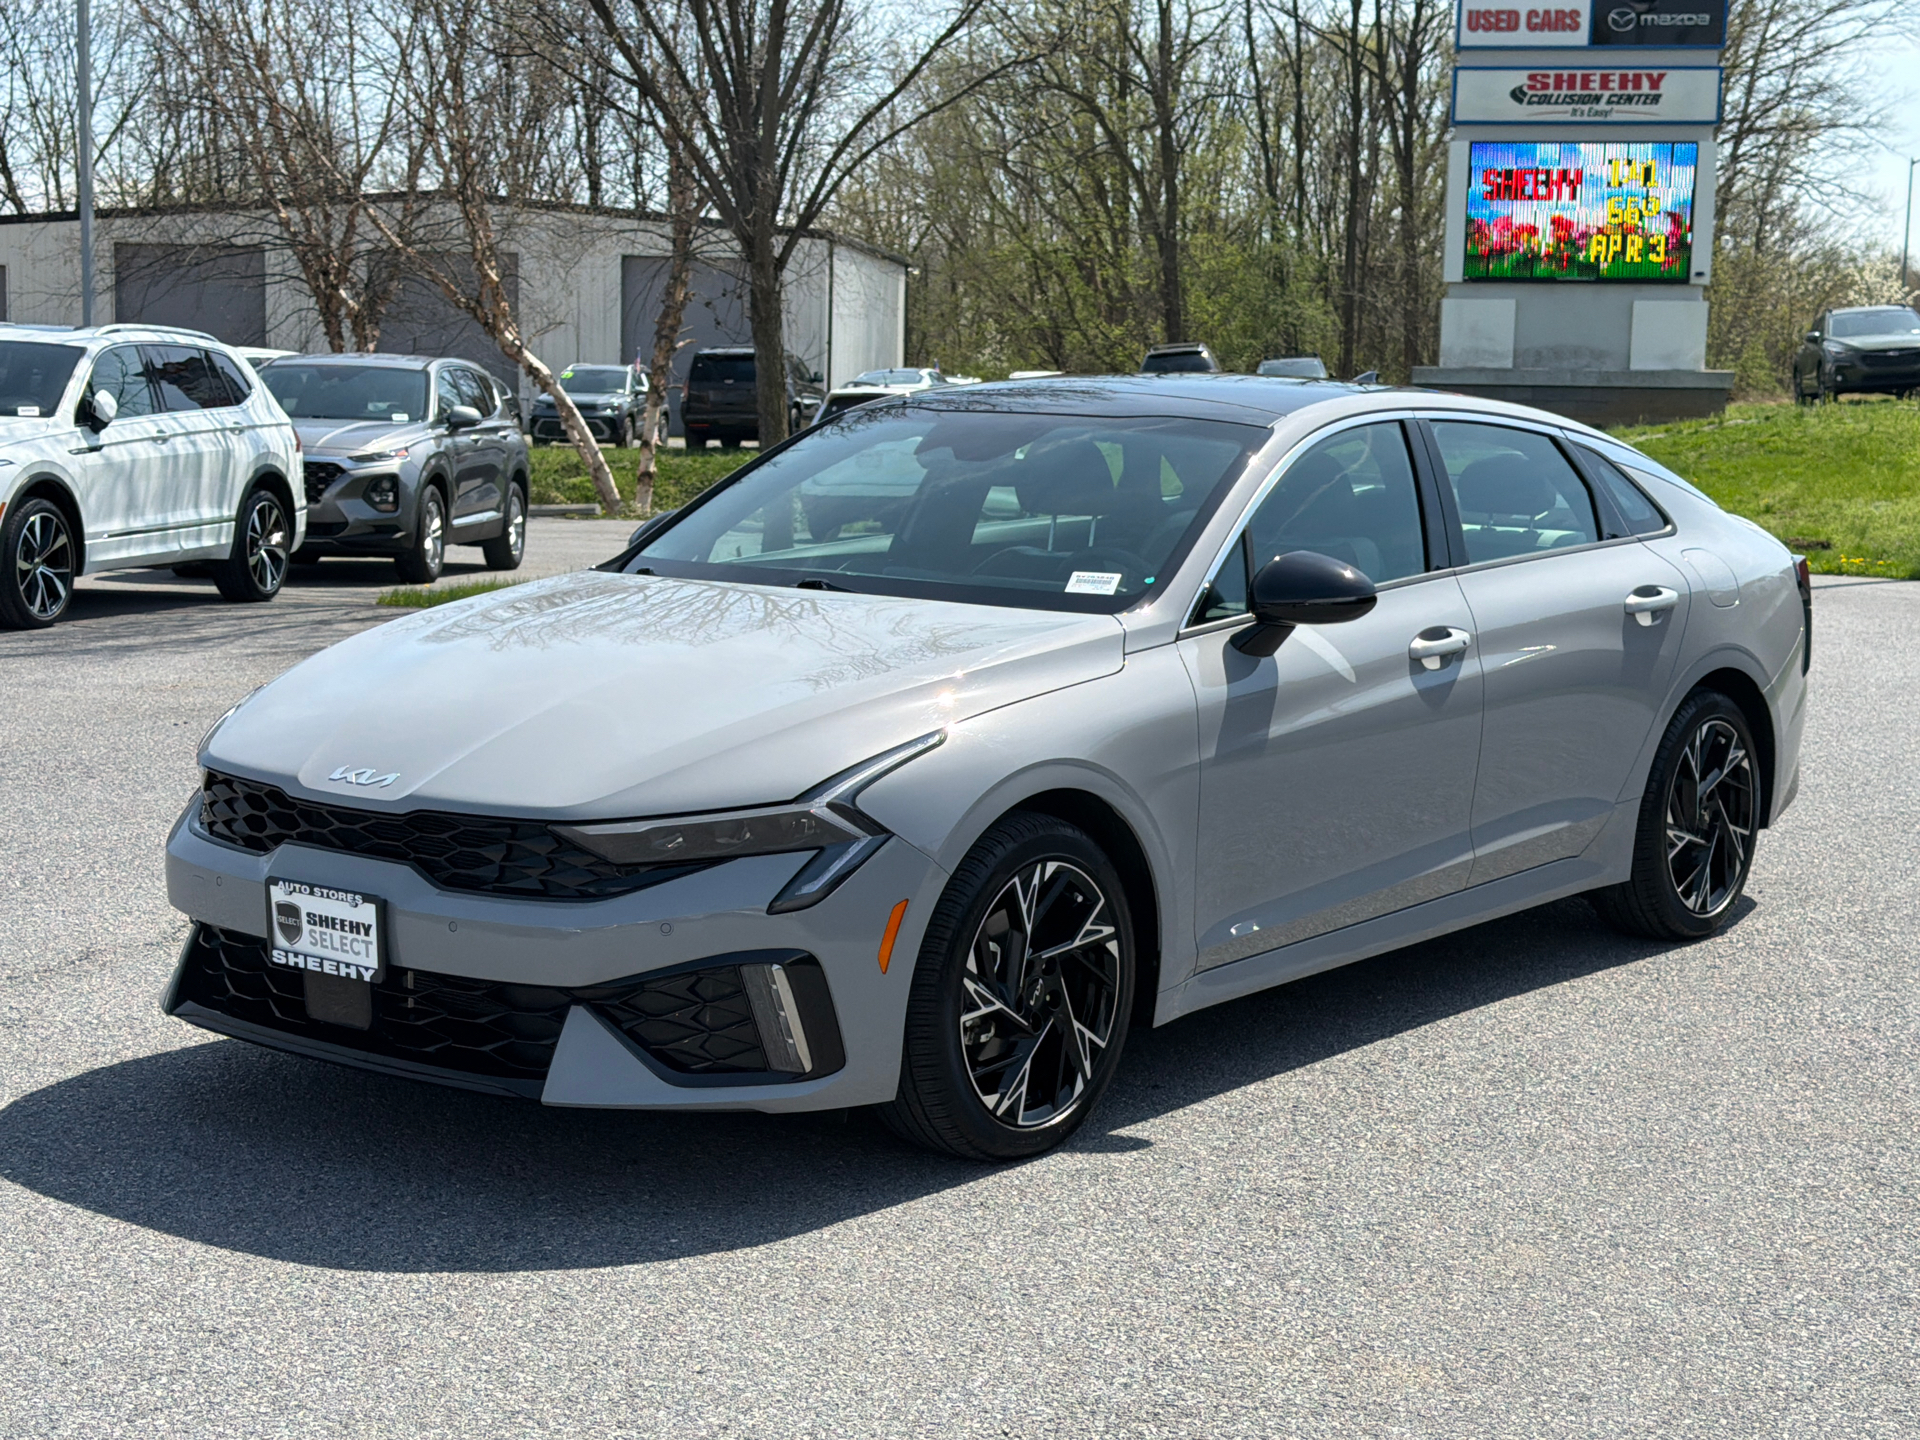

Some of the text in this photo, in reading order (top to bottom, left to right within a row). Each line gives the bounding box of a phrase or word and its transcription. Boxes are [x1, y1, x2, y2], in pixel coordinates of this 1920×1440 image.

[1467, 9, 1581, 33] USED CARS
[1640, 13, 1710, 26] mazda
[1527, 72, 1667, 91] SHEEHY
[1526, 93, 1662, 106] COLLISION CENTER
[1570, 107, 1614, 118] It's Easy!
[278, 881, 364, 905] AUTO STORES
[277, 915, 300, 927] SELECT
[306, 911, 373, 938] SHEEHY
[308, 929, 374, 959] SELECT
[272, 949, 376, 983] SHEEHY
